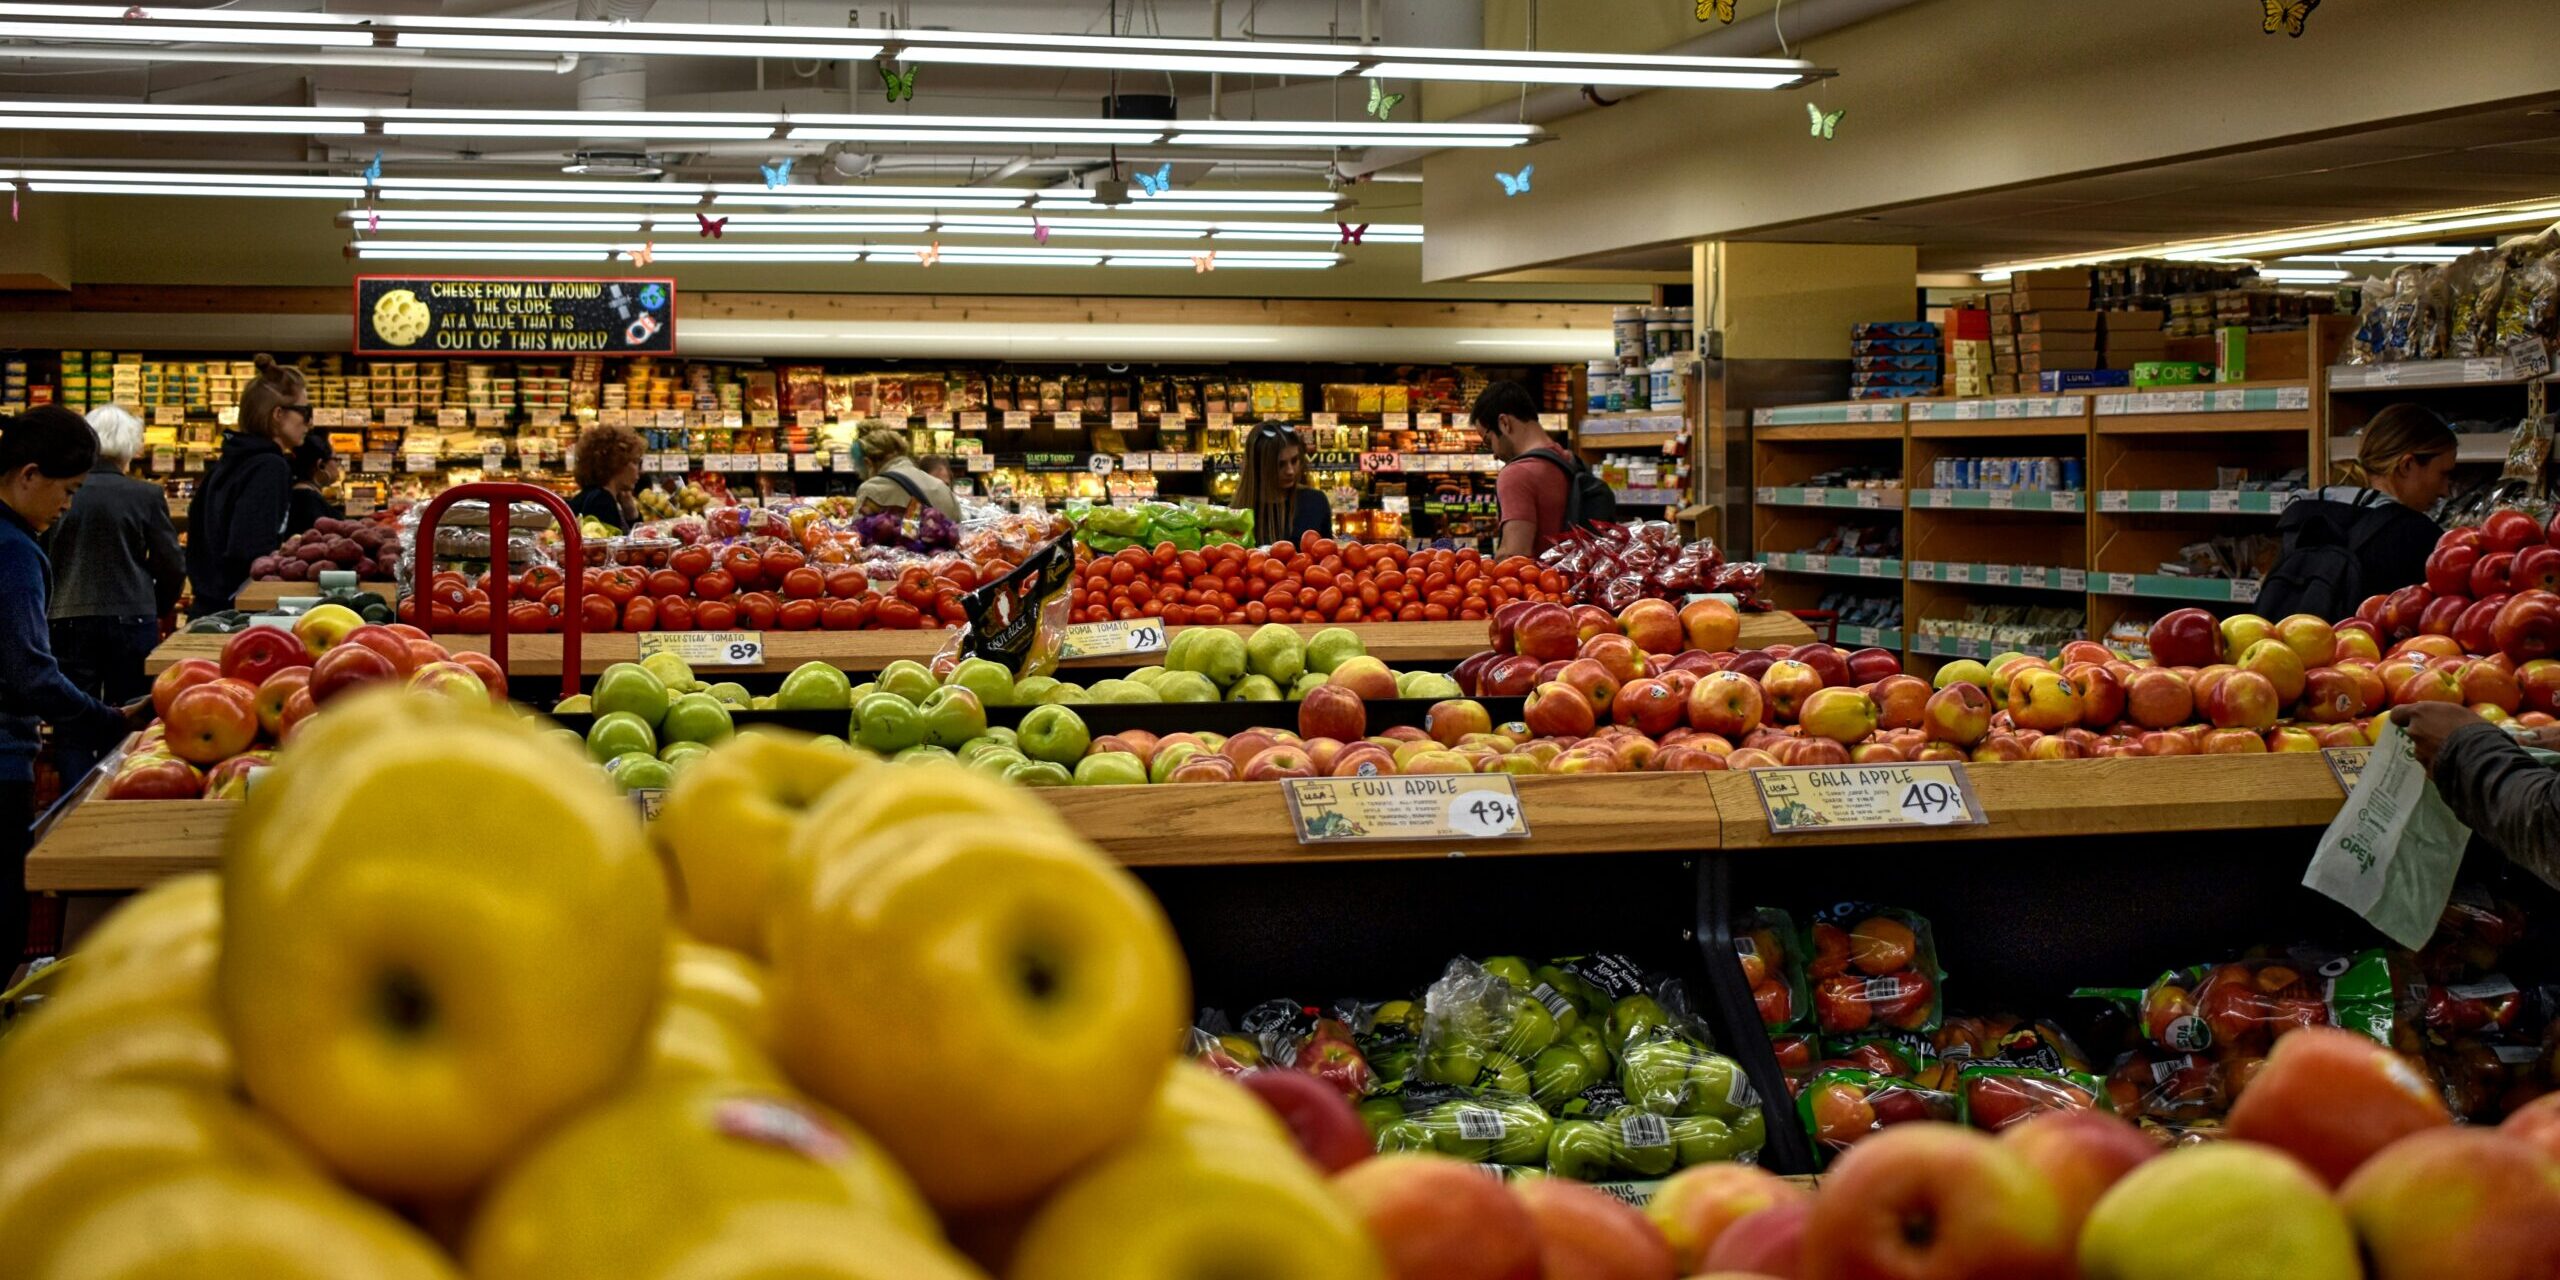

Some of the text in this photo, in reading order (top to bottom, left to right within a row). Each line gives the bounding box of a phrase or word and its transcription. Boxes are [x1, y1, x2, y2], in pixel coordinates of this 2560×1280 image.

[431, 283, 602, 299] CHEESE FROM ALL AROUND
[474, 299, 552, 314] THE GLOBE
[473, 316, 515, 329] VALUE
[519, 316, 555, 329] THAT
[560, 316, 574, 329] IS
[436, 331, 608, 350] OUT OF THIS WORLD
[2162, 366, 2192, 380] ONE
[1305, 453, 1355, 463] VIOLI
[1068, 622, 1129, 635] ROMA TOMATO
[711, 633, 744, 642] TOMATO
[1809, 769, 1913, 788] GALA APPLE
[1352, 778, 1458, 797] FUJI APPLE
[1769, 784, 1788, 792] USA
[1304, 792, 1327, 800] USA
[2340, 837, 2376, 867] OPEN
[1593, 962, 1624, 989] Apples
